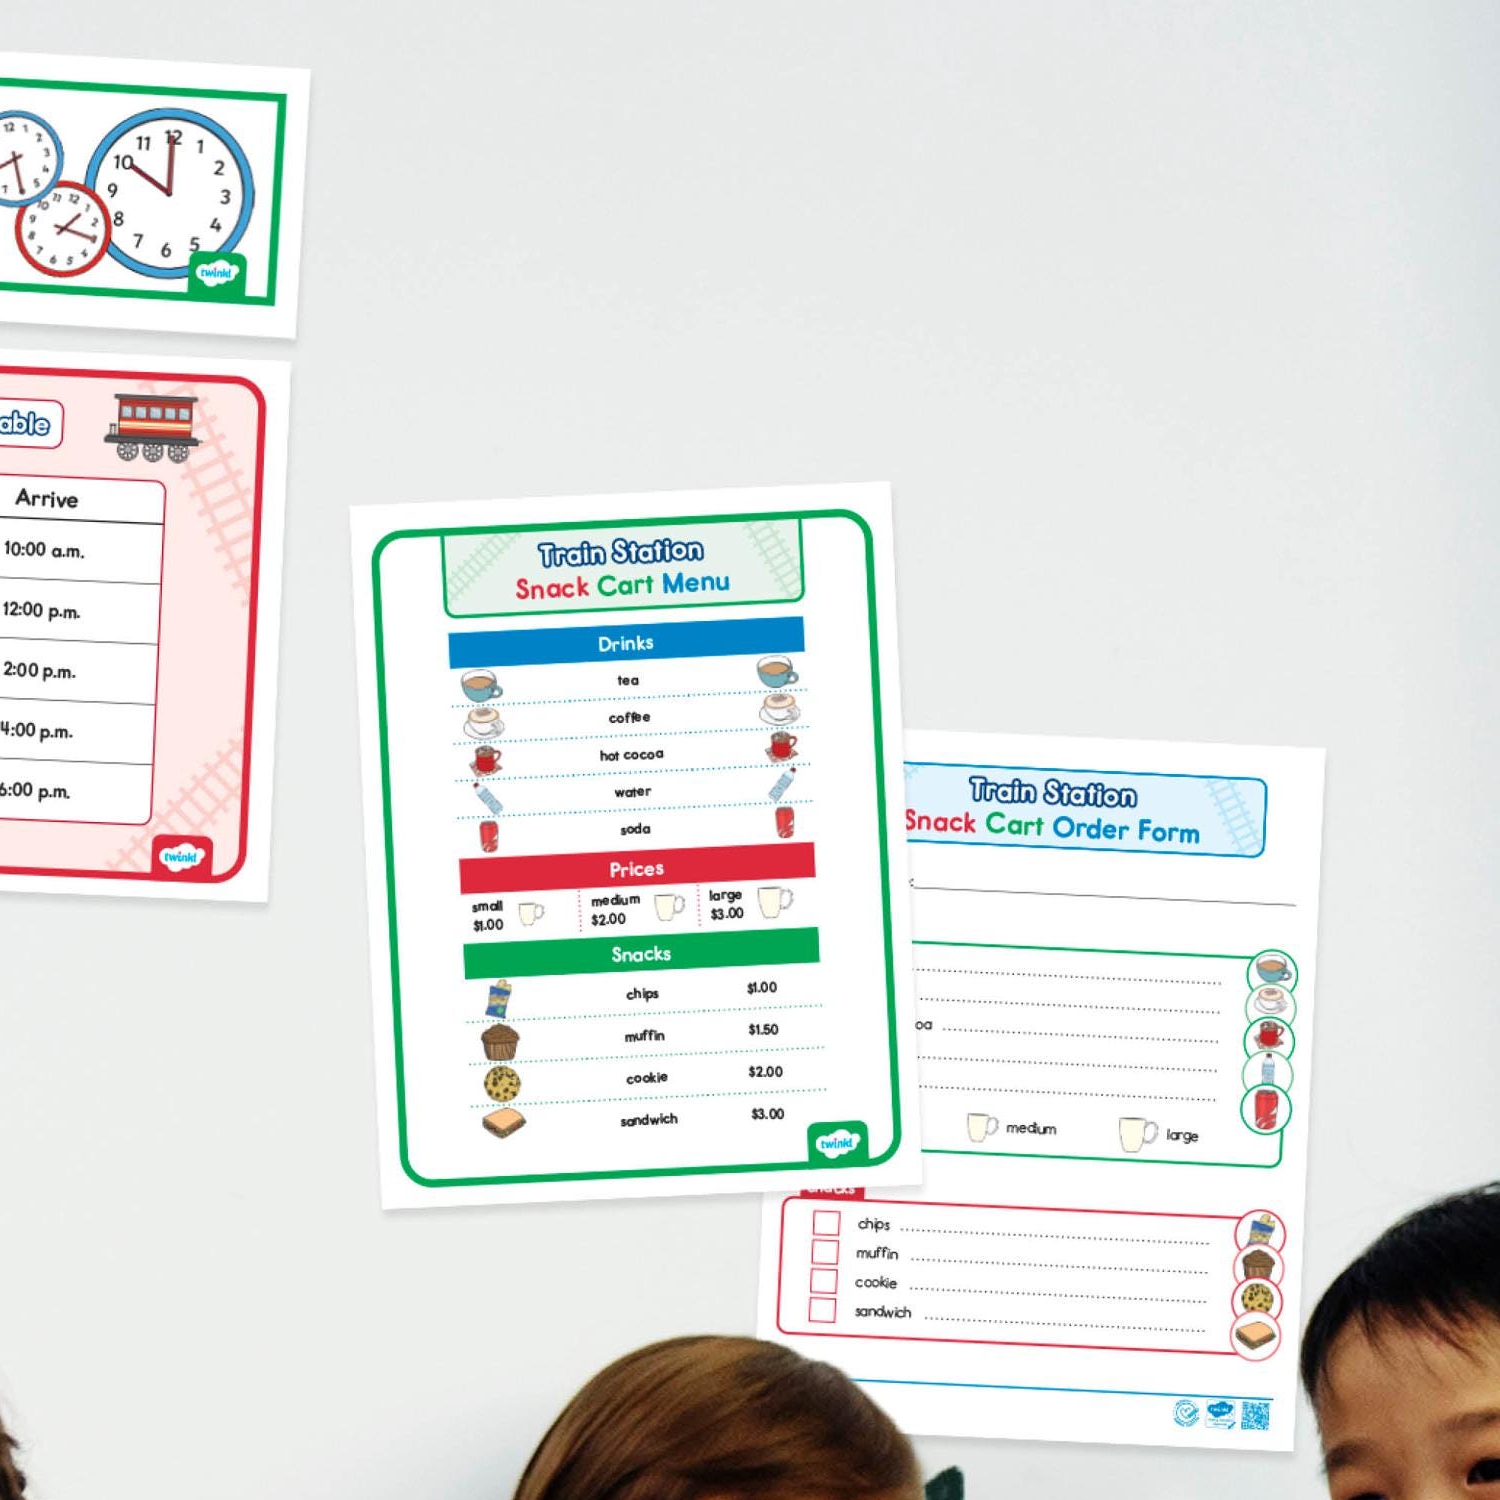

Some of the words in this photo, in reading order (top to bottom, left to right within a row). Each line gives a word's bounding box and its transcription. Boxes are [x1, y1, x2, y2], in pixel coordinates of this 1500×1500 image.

[4, 122, 14, 132] 12
[36, 133, 42, 142] 2
[136, 136, 150, 151] 11
[44, 148, 50, 156] 3
[197, 140, 203, 153] 1
[43, 165, 49, 173] 4
[114, 154, 133, 170] 10
[214, 161, 224, 175] 2
[2, 185, 8, 193] 7
[34, 178, 40, 188] 5
[108, 183, 117, 198] 9
[220, 189, 231, 205] 3
[114, 211, 124, 227] 8
[210, 218, 221, 232] 4
[134, 233, 143, 248] 7
[190, 237, 200, 252] 5
[161, 242, 171, 258] 6
[200, 267, 232, 278] twinkl
[15, 488, 78, 508] Arrive
[5, 540, 46, 556] 10:00
[51, 548, 84, 559] a.m.
[537, 541, 606, 568] Train
[611, 538, 704, 564] Station
[516, 576, 589, 599] Snack
[597, 575, 653, 596] Cart
[663, 572, 729, 593] Menu
[3, 601, 43, 617] 12:00
[48, 607, 80, 622] p.m.
[599, 635, 653, 652] Drinks
[4, 661, 38, 677] 2:00
[43, 667, 76, 682] p.m.
[618, 676, 639, 686] tea
[609, 712, 650, 723] coffee
[0, 721, 35, 737] 4:00
[40, 728, 73, 743] p.m.
[600, 750, 619, 761] hot
[623, 750, 663, 760] cocoa
[38, 788, 70, 803] p.m.
[615, 787, 651, 798] water
[969, 776, 1037, 804] Train
[1043, 778, 1138, 808] Station
[621, 822, 651, 835] soda
[906, 809, 975, 832] Snack
[986, 812, 1044, 835] Cart
[1053, 816, 1129, 840] Order
[1139, 819, 1199, 844] Form
[164, 851, 197, 862] twinkl
[610, 862, 664, 878] Prices
[592, 894, 640, 907] medium
[709, 890, 742, 904] large
[472, 900, 503, 913] small
[711, 907, 744, 920] $3.00
[474, 918, 503, 932] $1.00
[592, 912, 626, 926] $2.00
[612, 946, 671, 962] Snacks
[626, 987, 659, 1002] chips
[747, 981, 777, 995] $1.00
[625, 1029, 665, 1042] muffin
[749, 1024, 778, 1035] $1.50
[626, 1072, 668, 1085] cookie
[749, 1066, 783, 1077] $2.00
[621, 1113, 678, 1127] sandwich
[752, 1108, 784, 1120] $3.00
[1007, 1122, 1056, 1135] medium
[821, 1138, 852, 1148] twinkl
[1167, 1129, 1198, 1144] large
[858, 1218, 890, 1233] chips
[857, 1247, 898, 1260] muffin
[855, 1276, 897, 1289] cookie
[855, 1305, 911, 1318] sandwich
